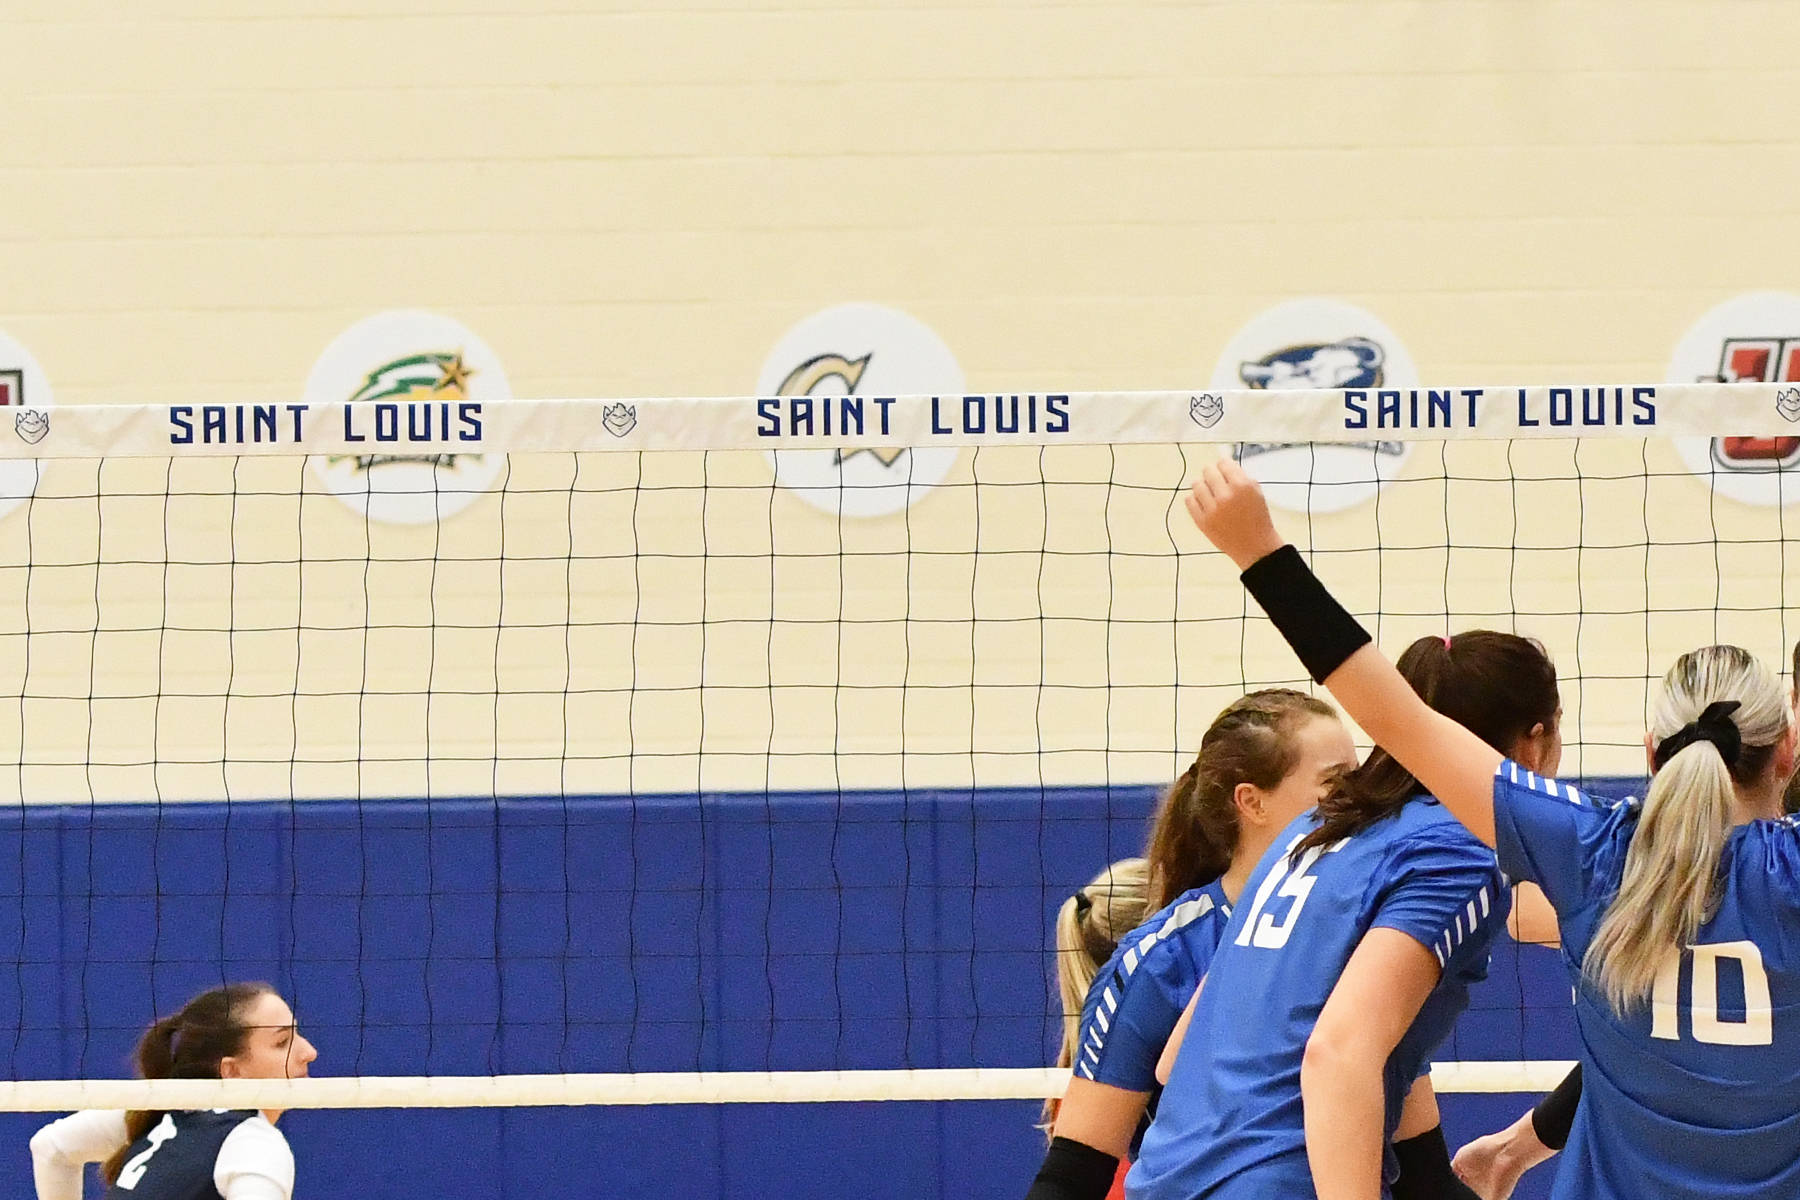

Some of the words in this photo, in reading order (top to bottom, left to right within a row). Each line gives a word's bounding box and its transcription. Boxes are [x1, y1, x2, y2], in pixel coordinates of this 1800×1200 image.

[169, 405, 309, 444] SAINT
[344, 403, 483, 442] LOUIS
[757, 397, 896, 437] SAINT
[931, 396, 1070, 435] LOUIS
[1344, 389, 1484, 429] SAINT
[1518, 387, 1656, 427] LOUIS
[1234, 833, 1352, 949] 15
[1650, 940, 1772, 1046] 10
[116, 1112, 178, 1190] 2
